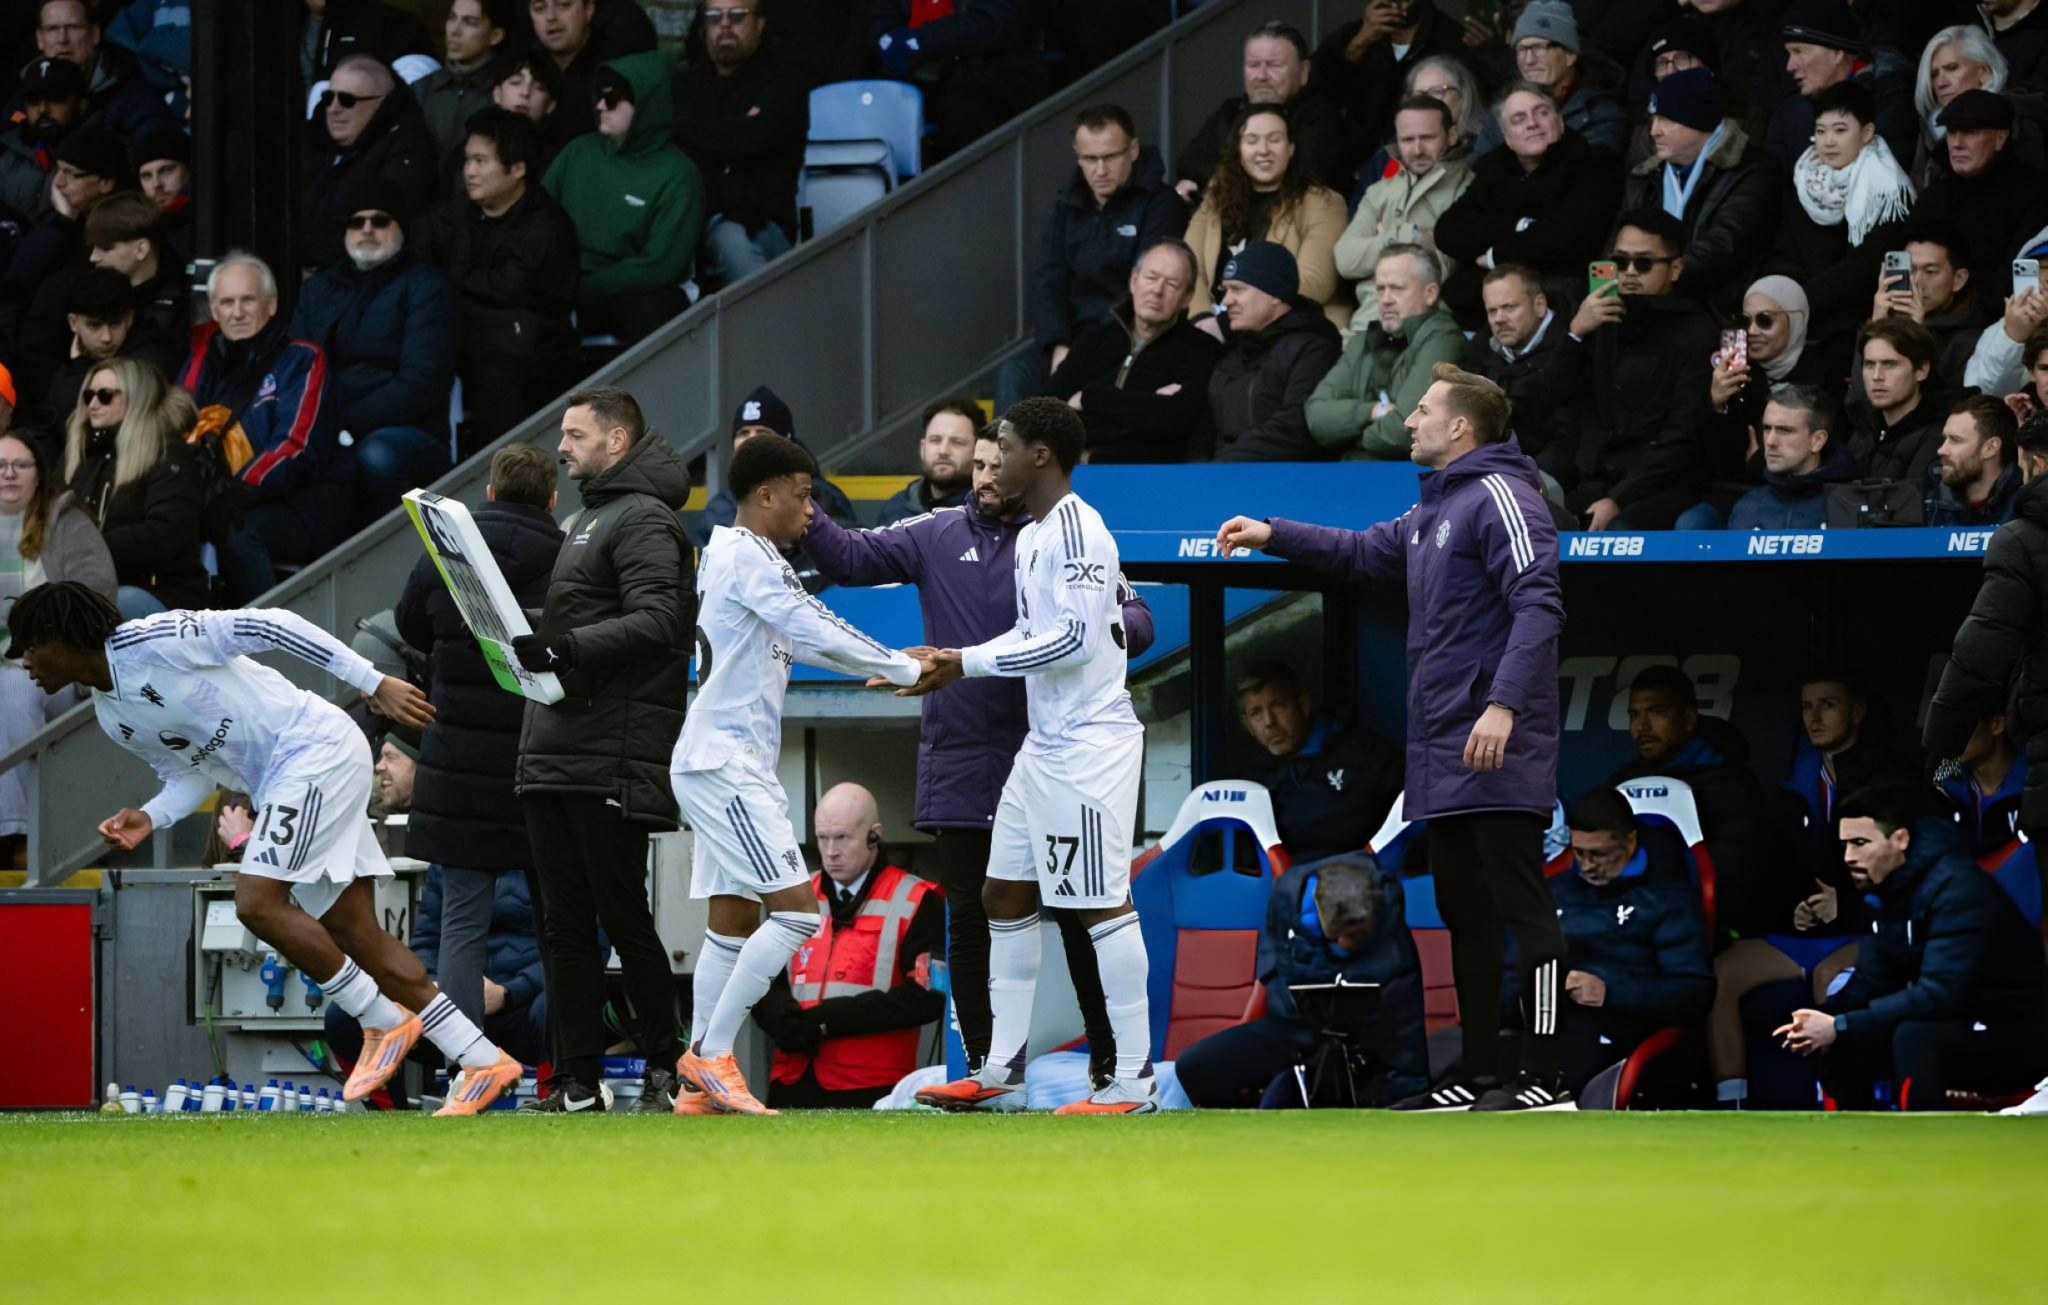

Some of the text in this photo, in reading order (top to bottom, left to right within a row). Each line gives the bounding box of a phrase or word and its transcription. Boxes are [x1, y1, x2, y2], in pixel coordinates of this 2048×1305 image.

[1568, 536, 1645, 556] NET88
[1747, 534, 1824, 555] NET88
[1064, 562, 1105, 585] DXC
[258, 804, 299, 845] 13
[1046, 834, 1080, 875] 37
